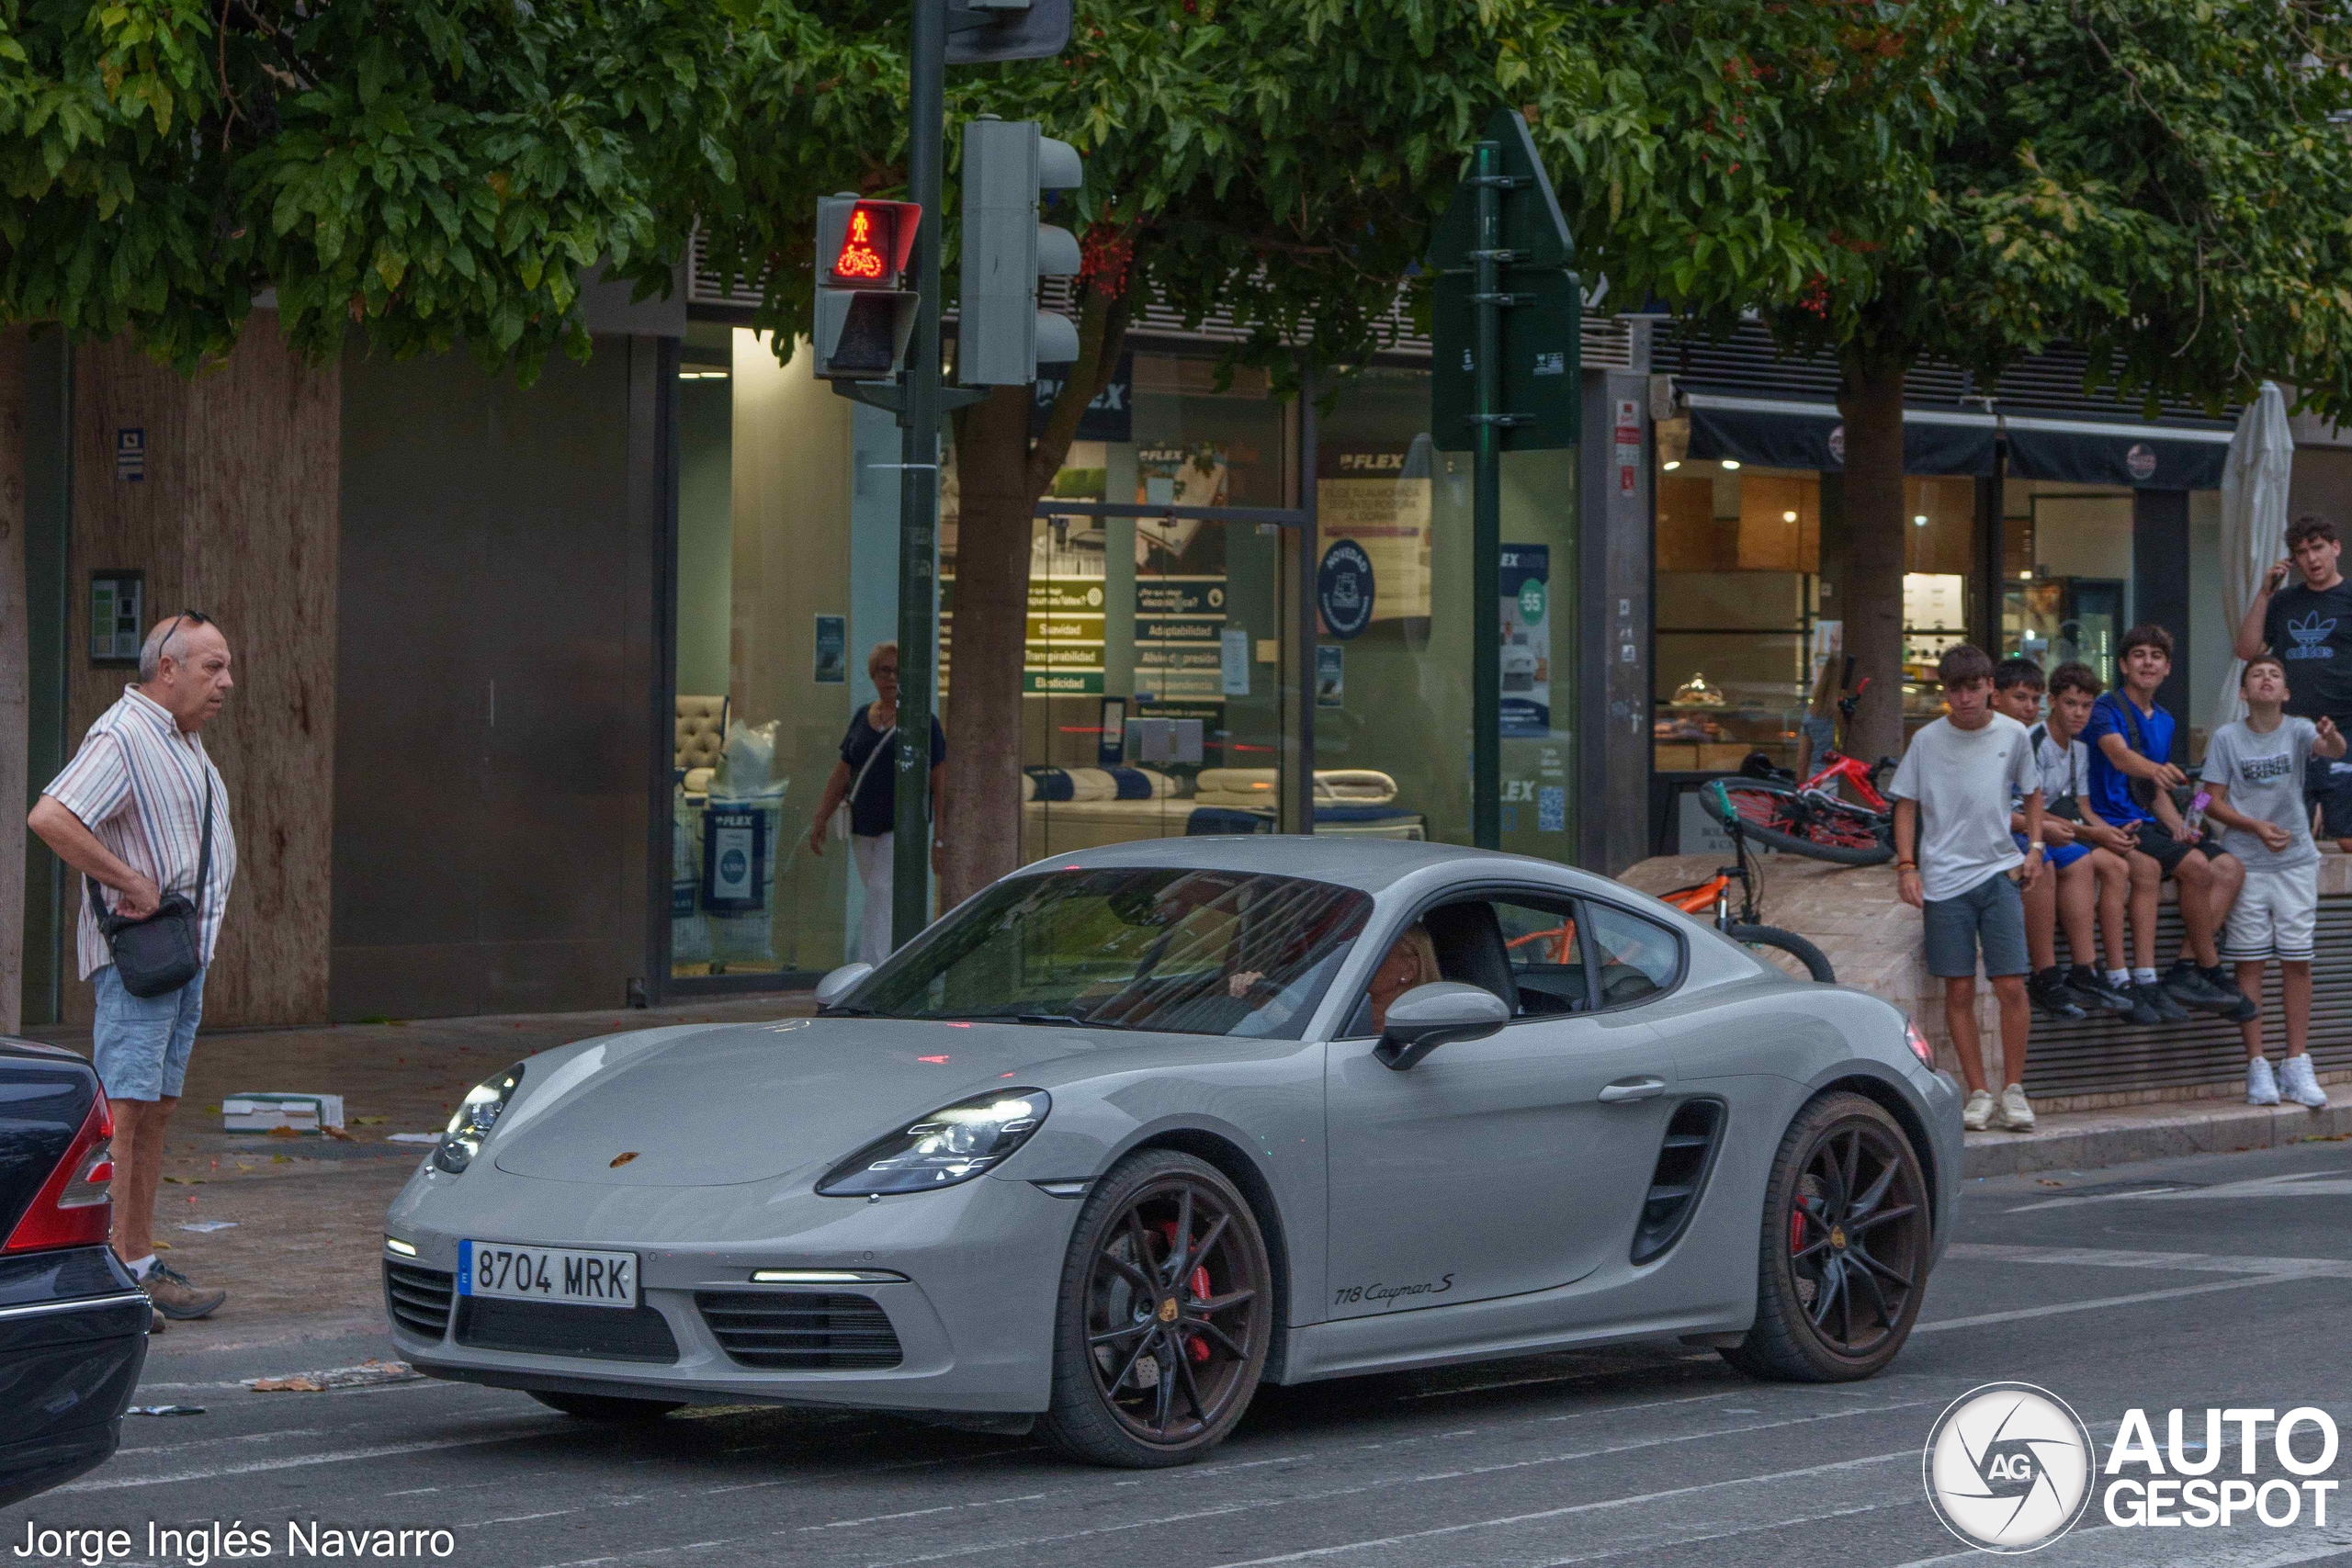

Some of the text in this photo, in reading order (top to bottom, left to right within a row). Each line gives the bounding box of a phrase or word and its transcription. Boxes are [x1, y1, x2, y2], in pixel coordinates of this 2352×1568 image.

[1351, 453, 1405, 469] FLEX
[1326, 547, 1368, 572] NOVEDAD
[2286, 644, 2333, 660] adidas
[479, 1250, 628, 1299] 8704 MRK
[1334, 1273, 1456, 1308] 718 Cayman S
